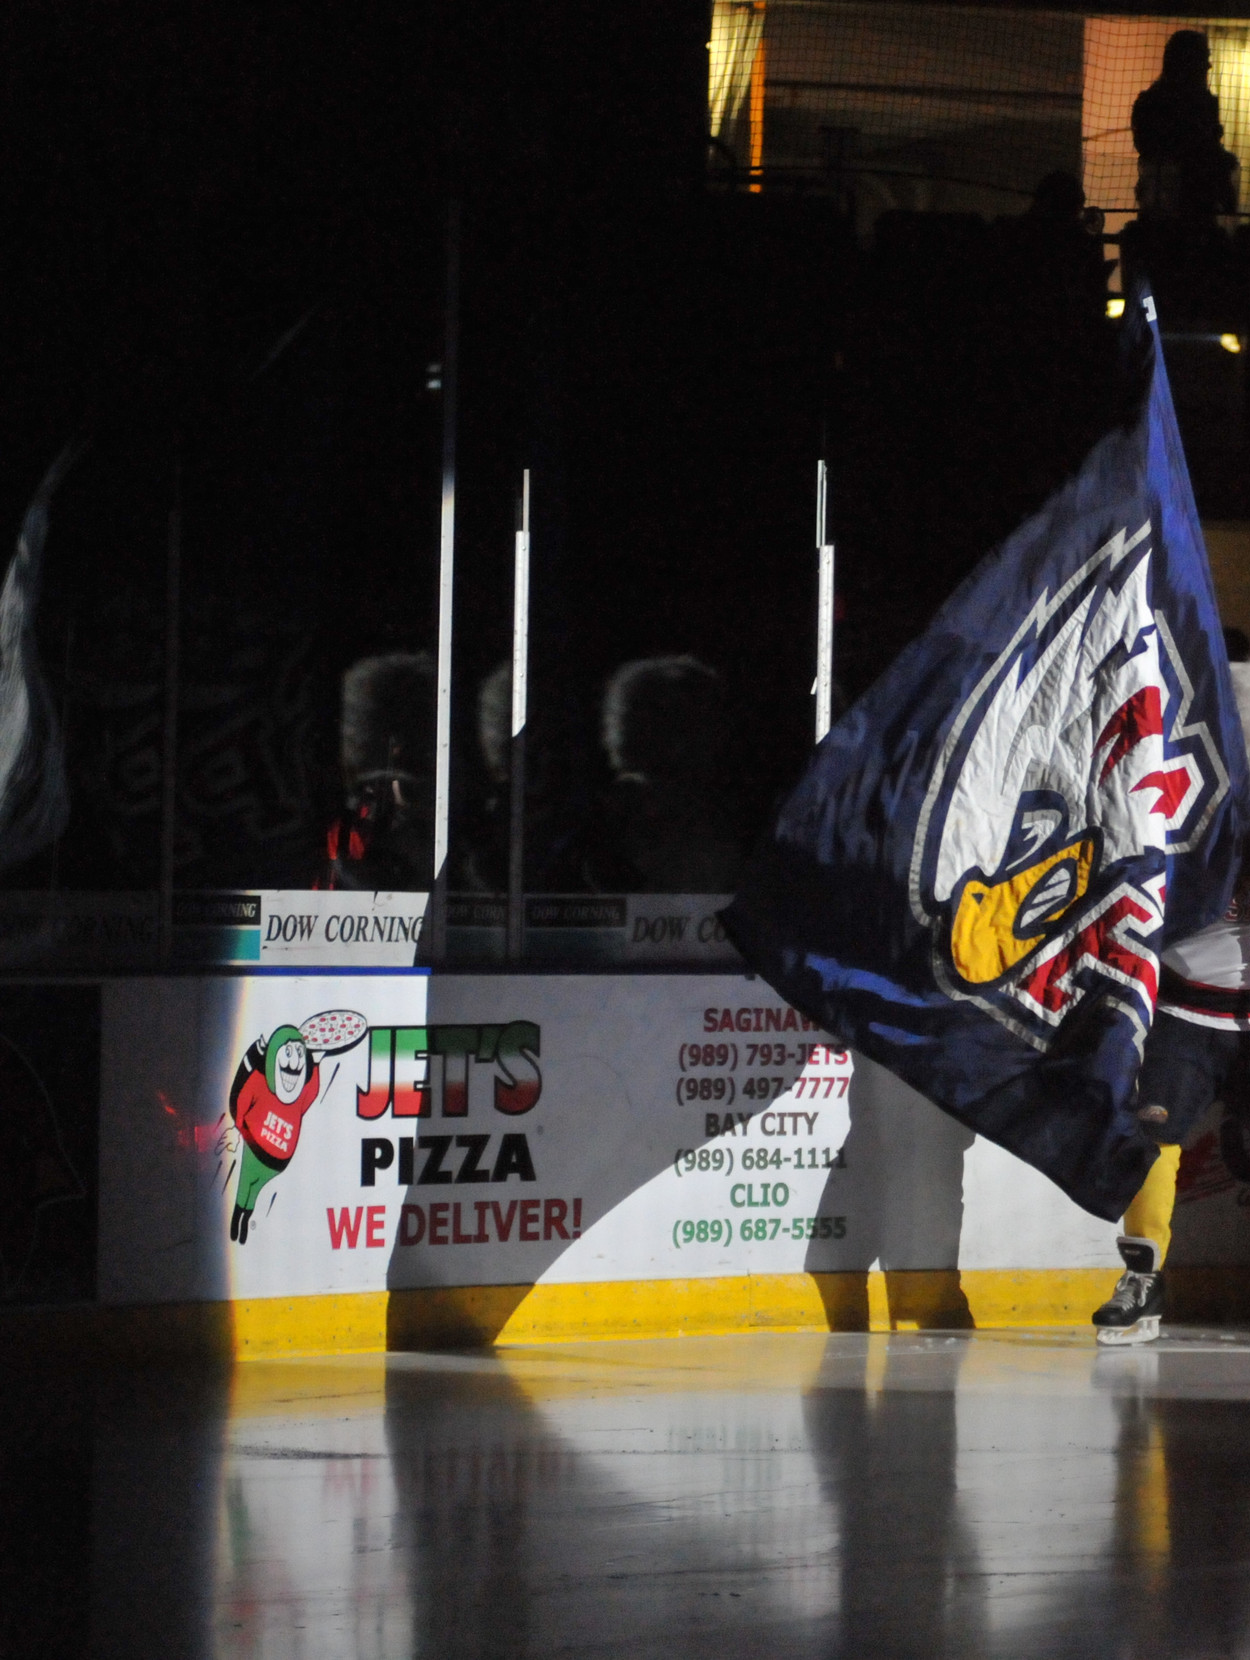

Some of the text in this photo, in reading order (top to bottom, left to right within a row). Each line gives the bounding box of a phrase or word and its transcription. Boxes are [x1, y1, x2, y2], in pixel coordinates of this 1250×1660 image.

[266, 914, 426, 944] DOW CORNING
[632, 916, 688, 943] DOW
[356, 1020, 542, 1120] JET'S
[678, 1043, 848, 1072] (989) 793-JETS
[676, 1076, 850, 1106] (989) 497-7777
[263, 1111, 294, 1140] JET'S
[705, 1111, 819, 1137] BAY CITY
[261, 1127, 289, 1152] PIZZA
[360, 1133, 537, 1187] PIZZA
[674, 1147, 848, 1177] (989) 684-1111
[729, 1182, 790, 1208] CLIO
[327, 1197, 583, 1250] WE DELIVER!
[672, 1216, 847, 1249] (989) 687-5555
